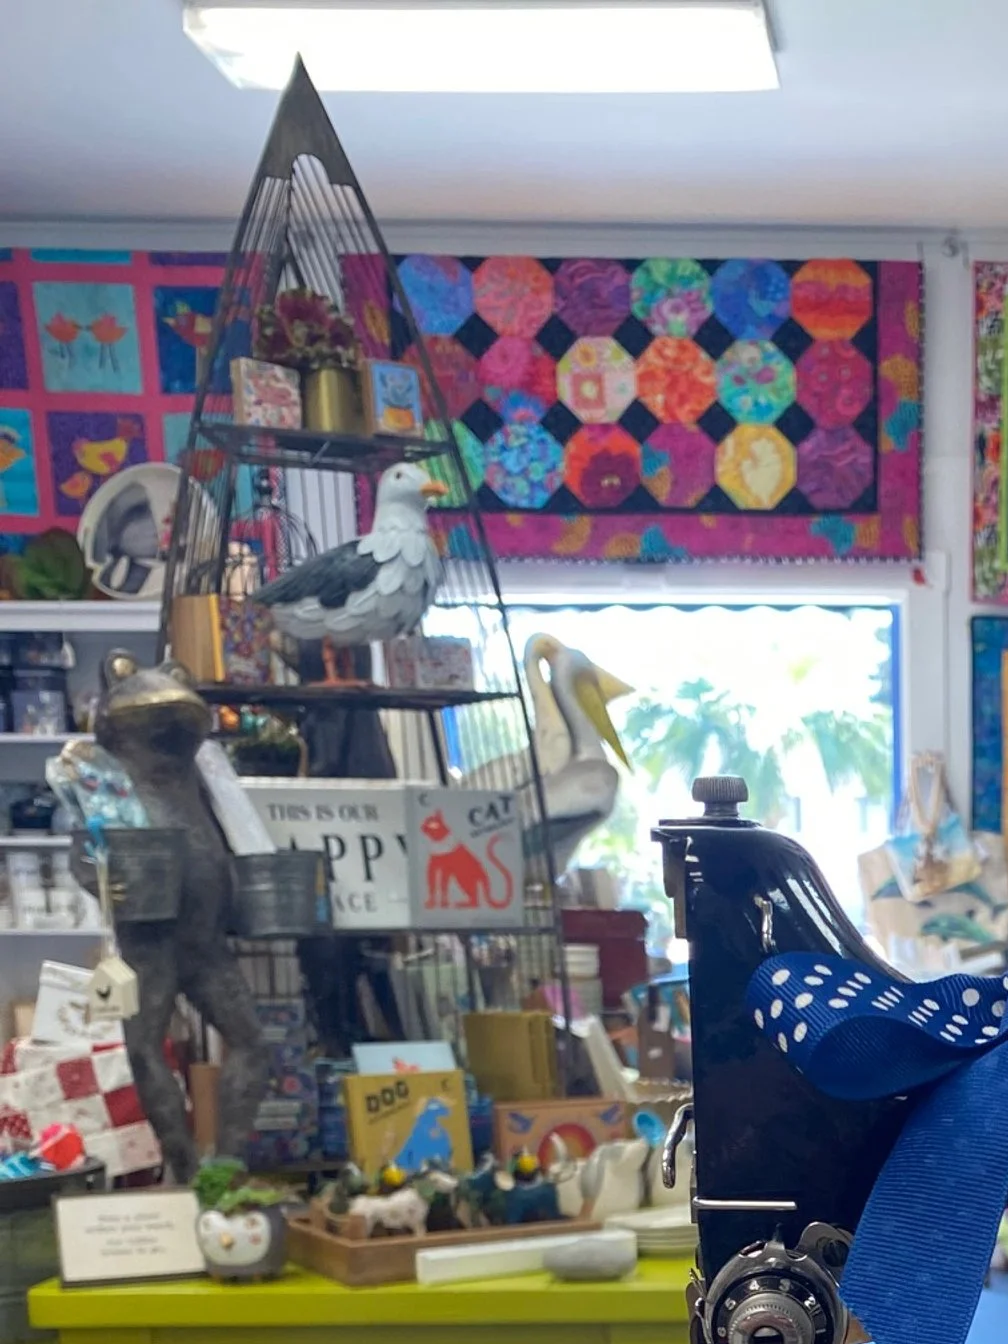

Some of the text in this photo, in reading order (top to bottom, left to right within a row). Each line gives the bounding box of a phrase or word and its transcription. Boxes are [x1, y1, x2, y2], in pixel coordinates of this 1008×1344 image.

[267, 804, 379, 821] THIS IS OUR
[468, 792, 514, 829] CAT
[749, 1279, 760, 1291] 4
[779, 1279, 791, 1291] 3
[724, 1298, 736, 1310] 5
